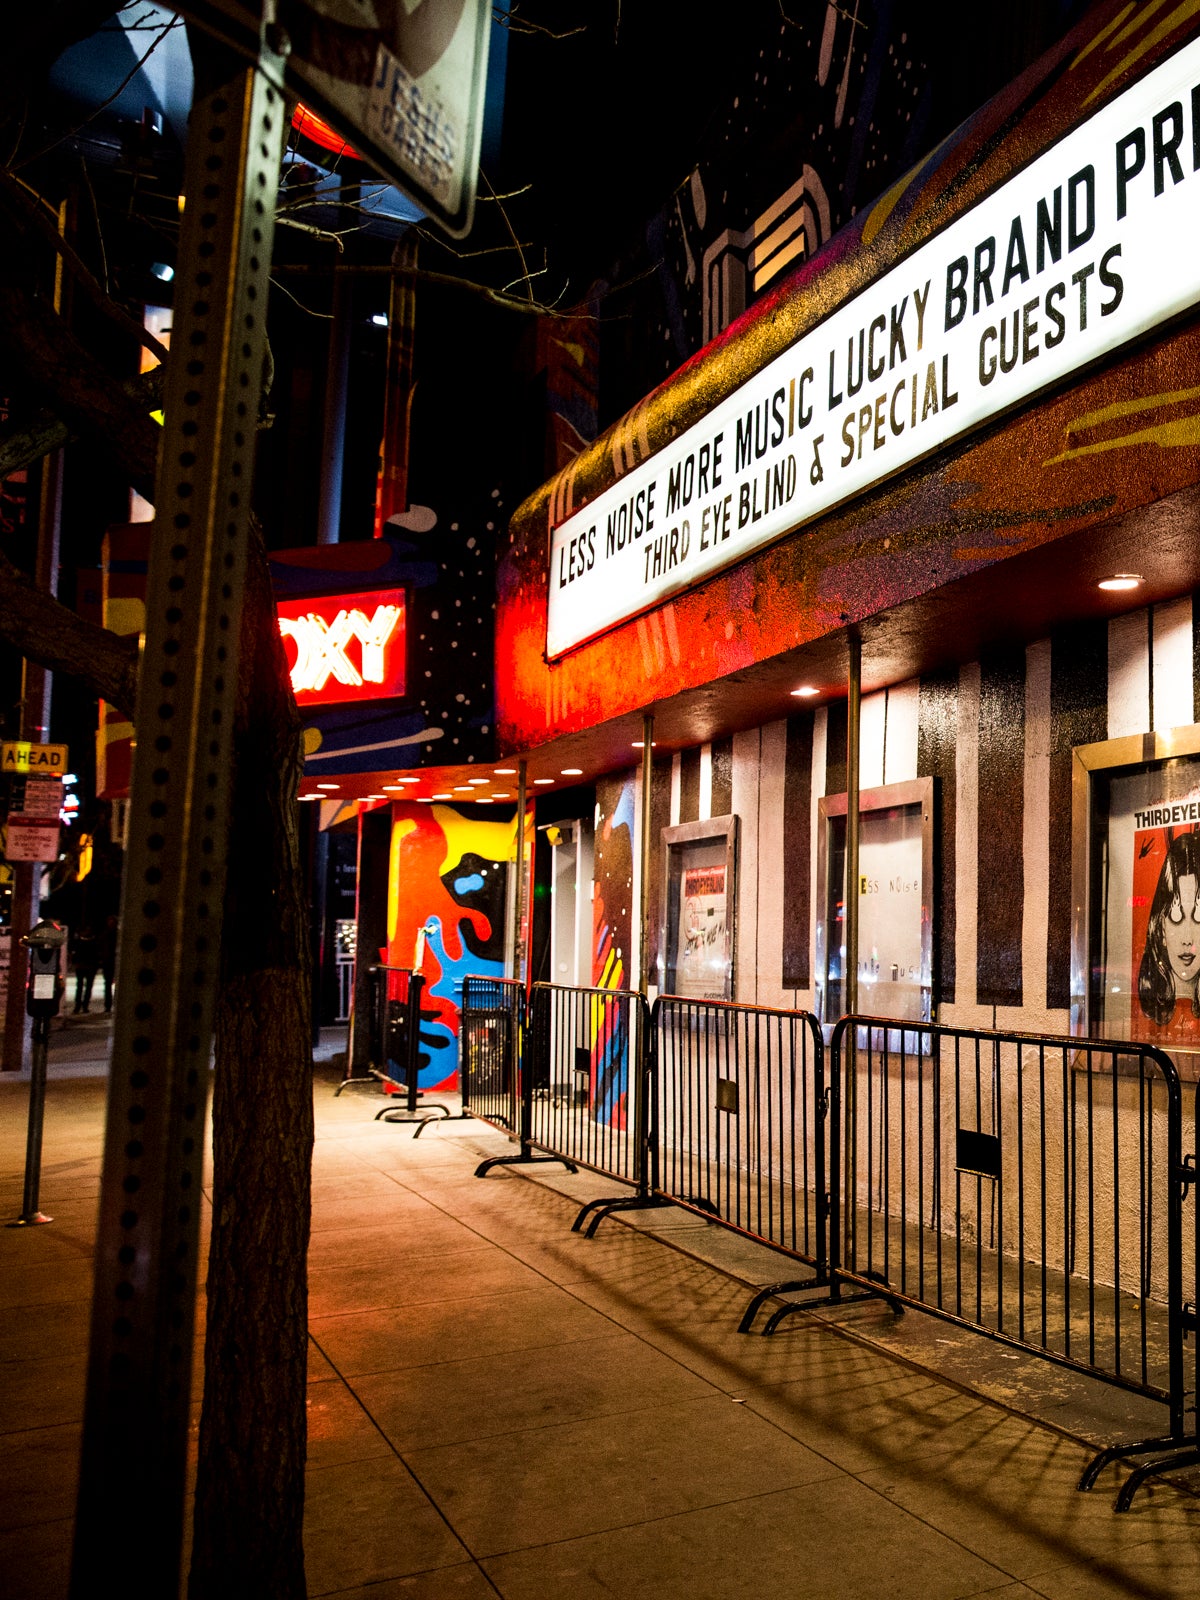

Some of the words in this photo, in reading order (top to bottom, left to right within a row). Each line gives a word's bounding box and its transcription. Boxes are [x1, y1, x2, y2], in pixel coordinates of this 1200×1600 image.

[560, 525, 596, 589] LESS
[606, 481, 656, 559] NOISE
[666, 432, 723, 518] MORE
[736, 367, 814, 474] MUSIC
[828, 279, 931, 411] LUCKY
[944, 163, 1095, 333] BRAND
[644, 519, 690, 584] THIRD
[700, 494, 732, 552] EYE
[738, 454, 797, 530] BLIND
[810, 433, 824, 486] &
[841, 353, 959, 468] SPECIAL
[978, 243, 1124, 387] GUESTS
[278, 604, 401, 693] OXY
[6, 750, 61, 766] AHEAD
[861, 878, 879, 895] ESS
